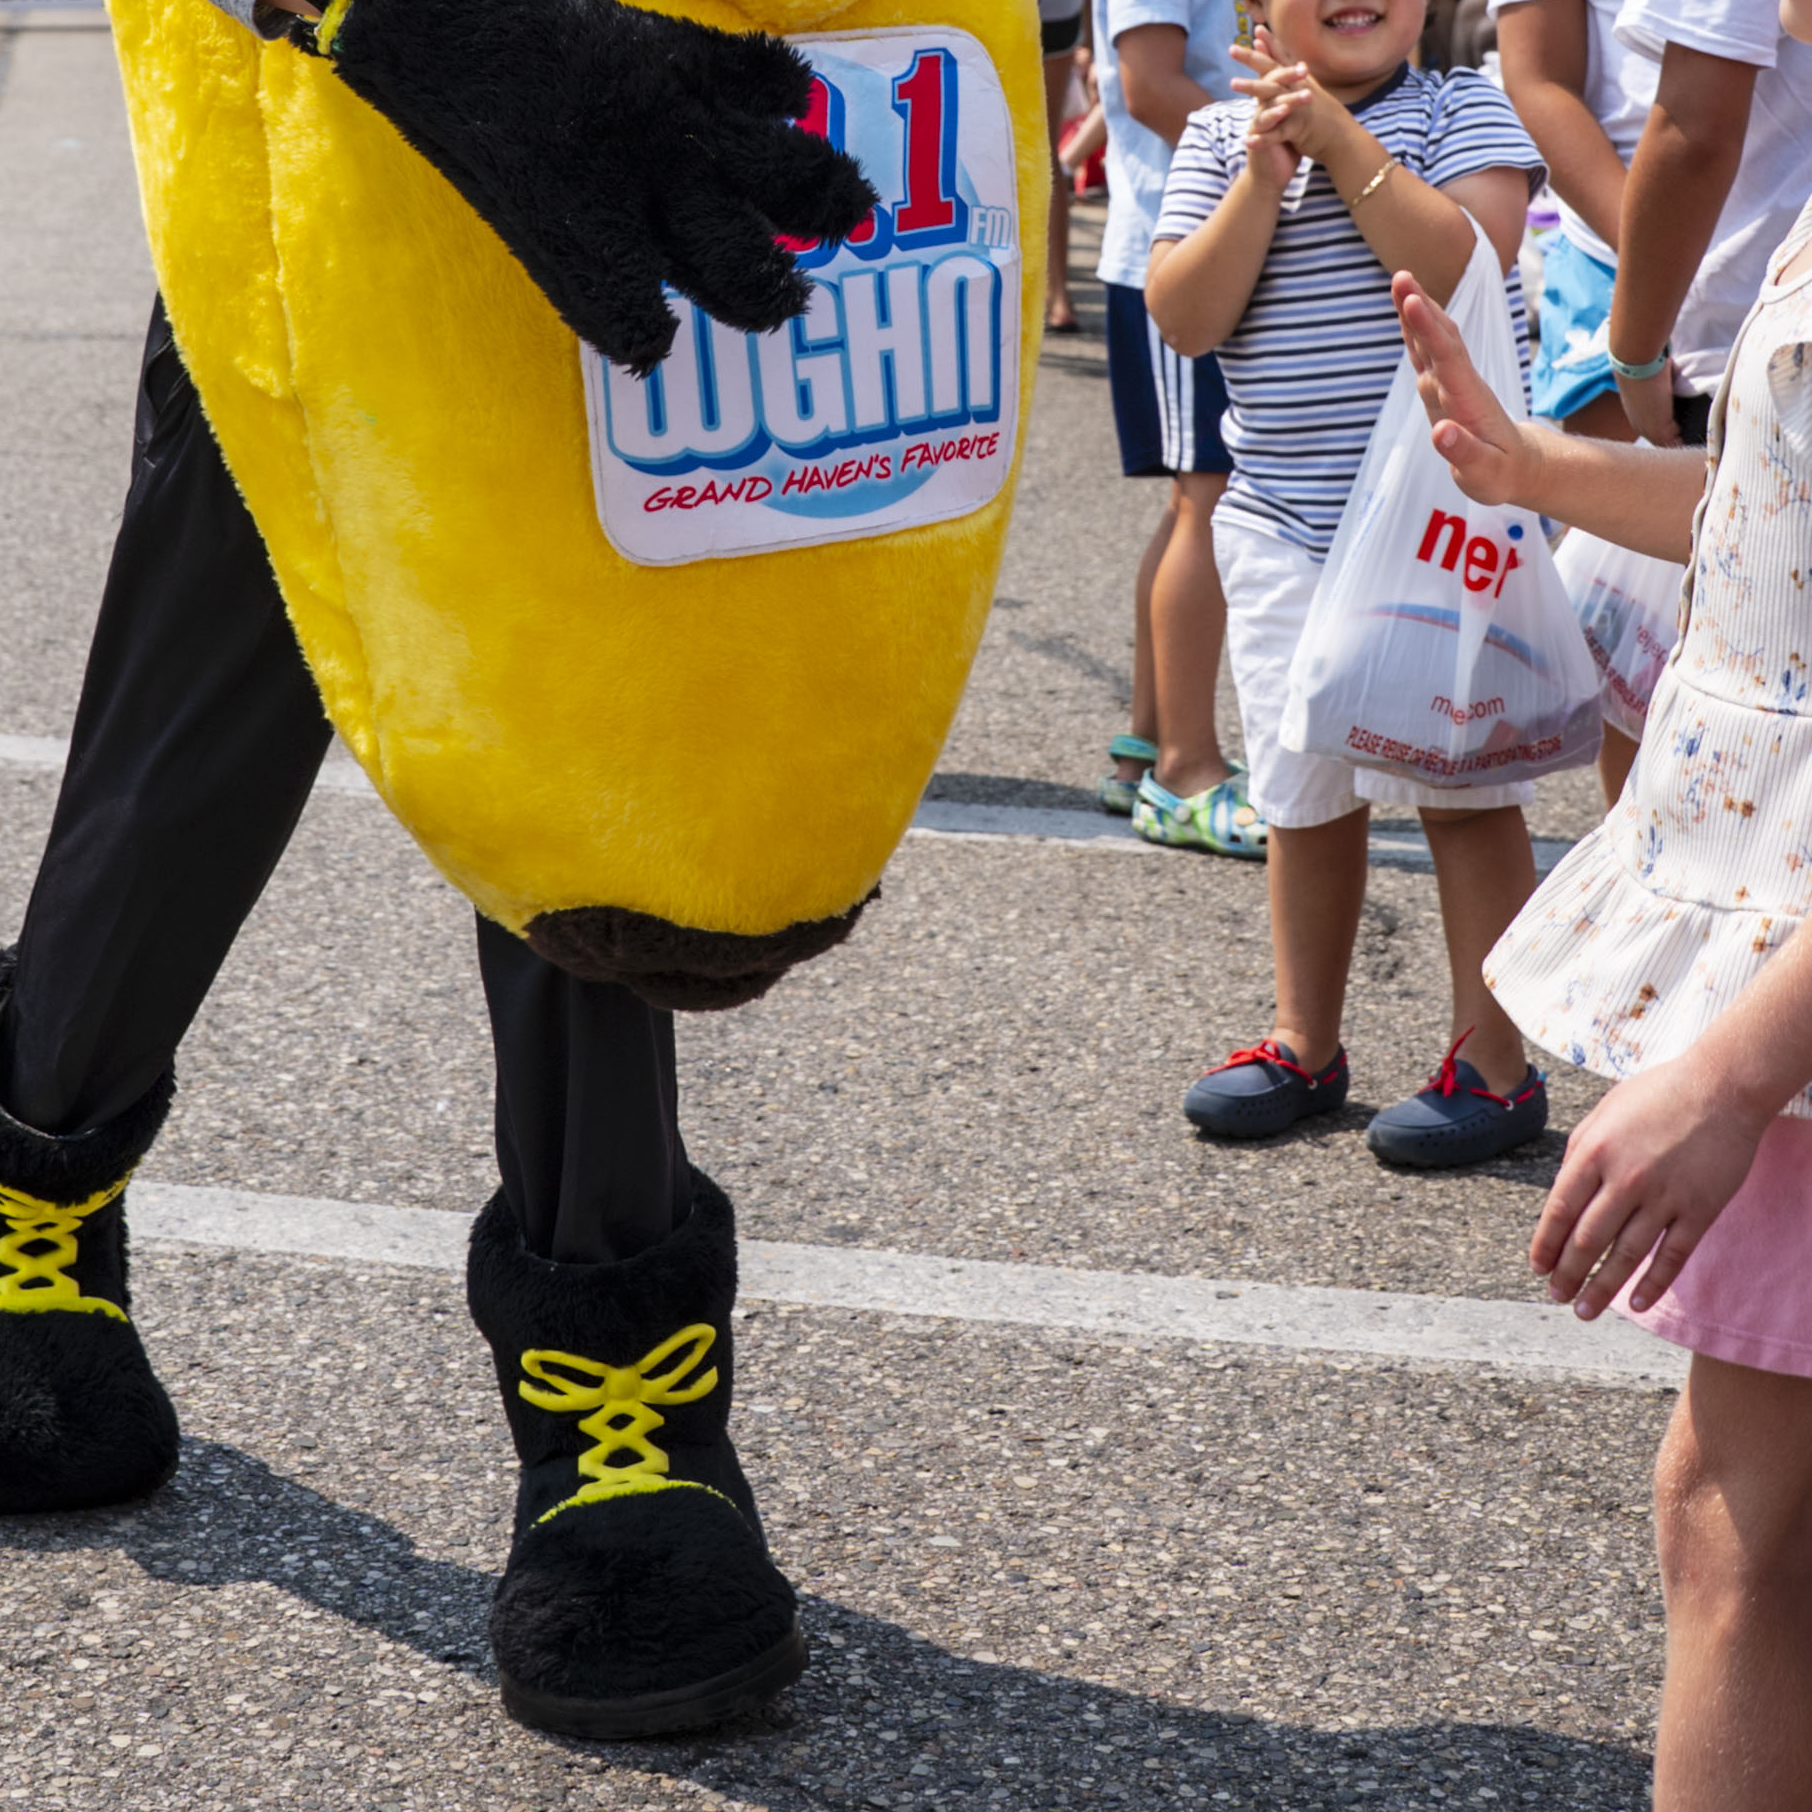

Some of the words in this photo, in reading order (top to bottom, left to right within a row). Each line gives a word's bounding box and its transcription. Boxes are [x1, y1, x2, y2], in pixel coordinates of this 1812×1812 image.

[969, 205, 1011, 249] FM
[600, 250, 1002, 478] WGHN
[643, 475, 774, 513] GRAND
[781, 452, 893, 496] HAVEN'S
[900, 431, 1001, 474] FAVORITE
